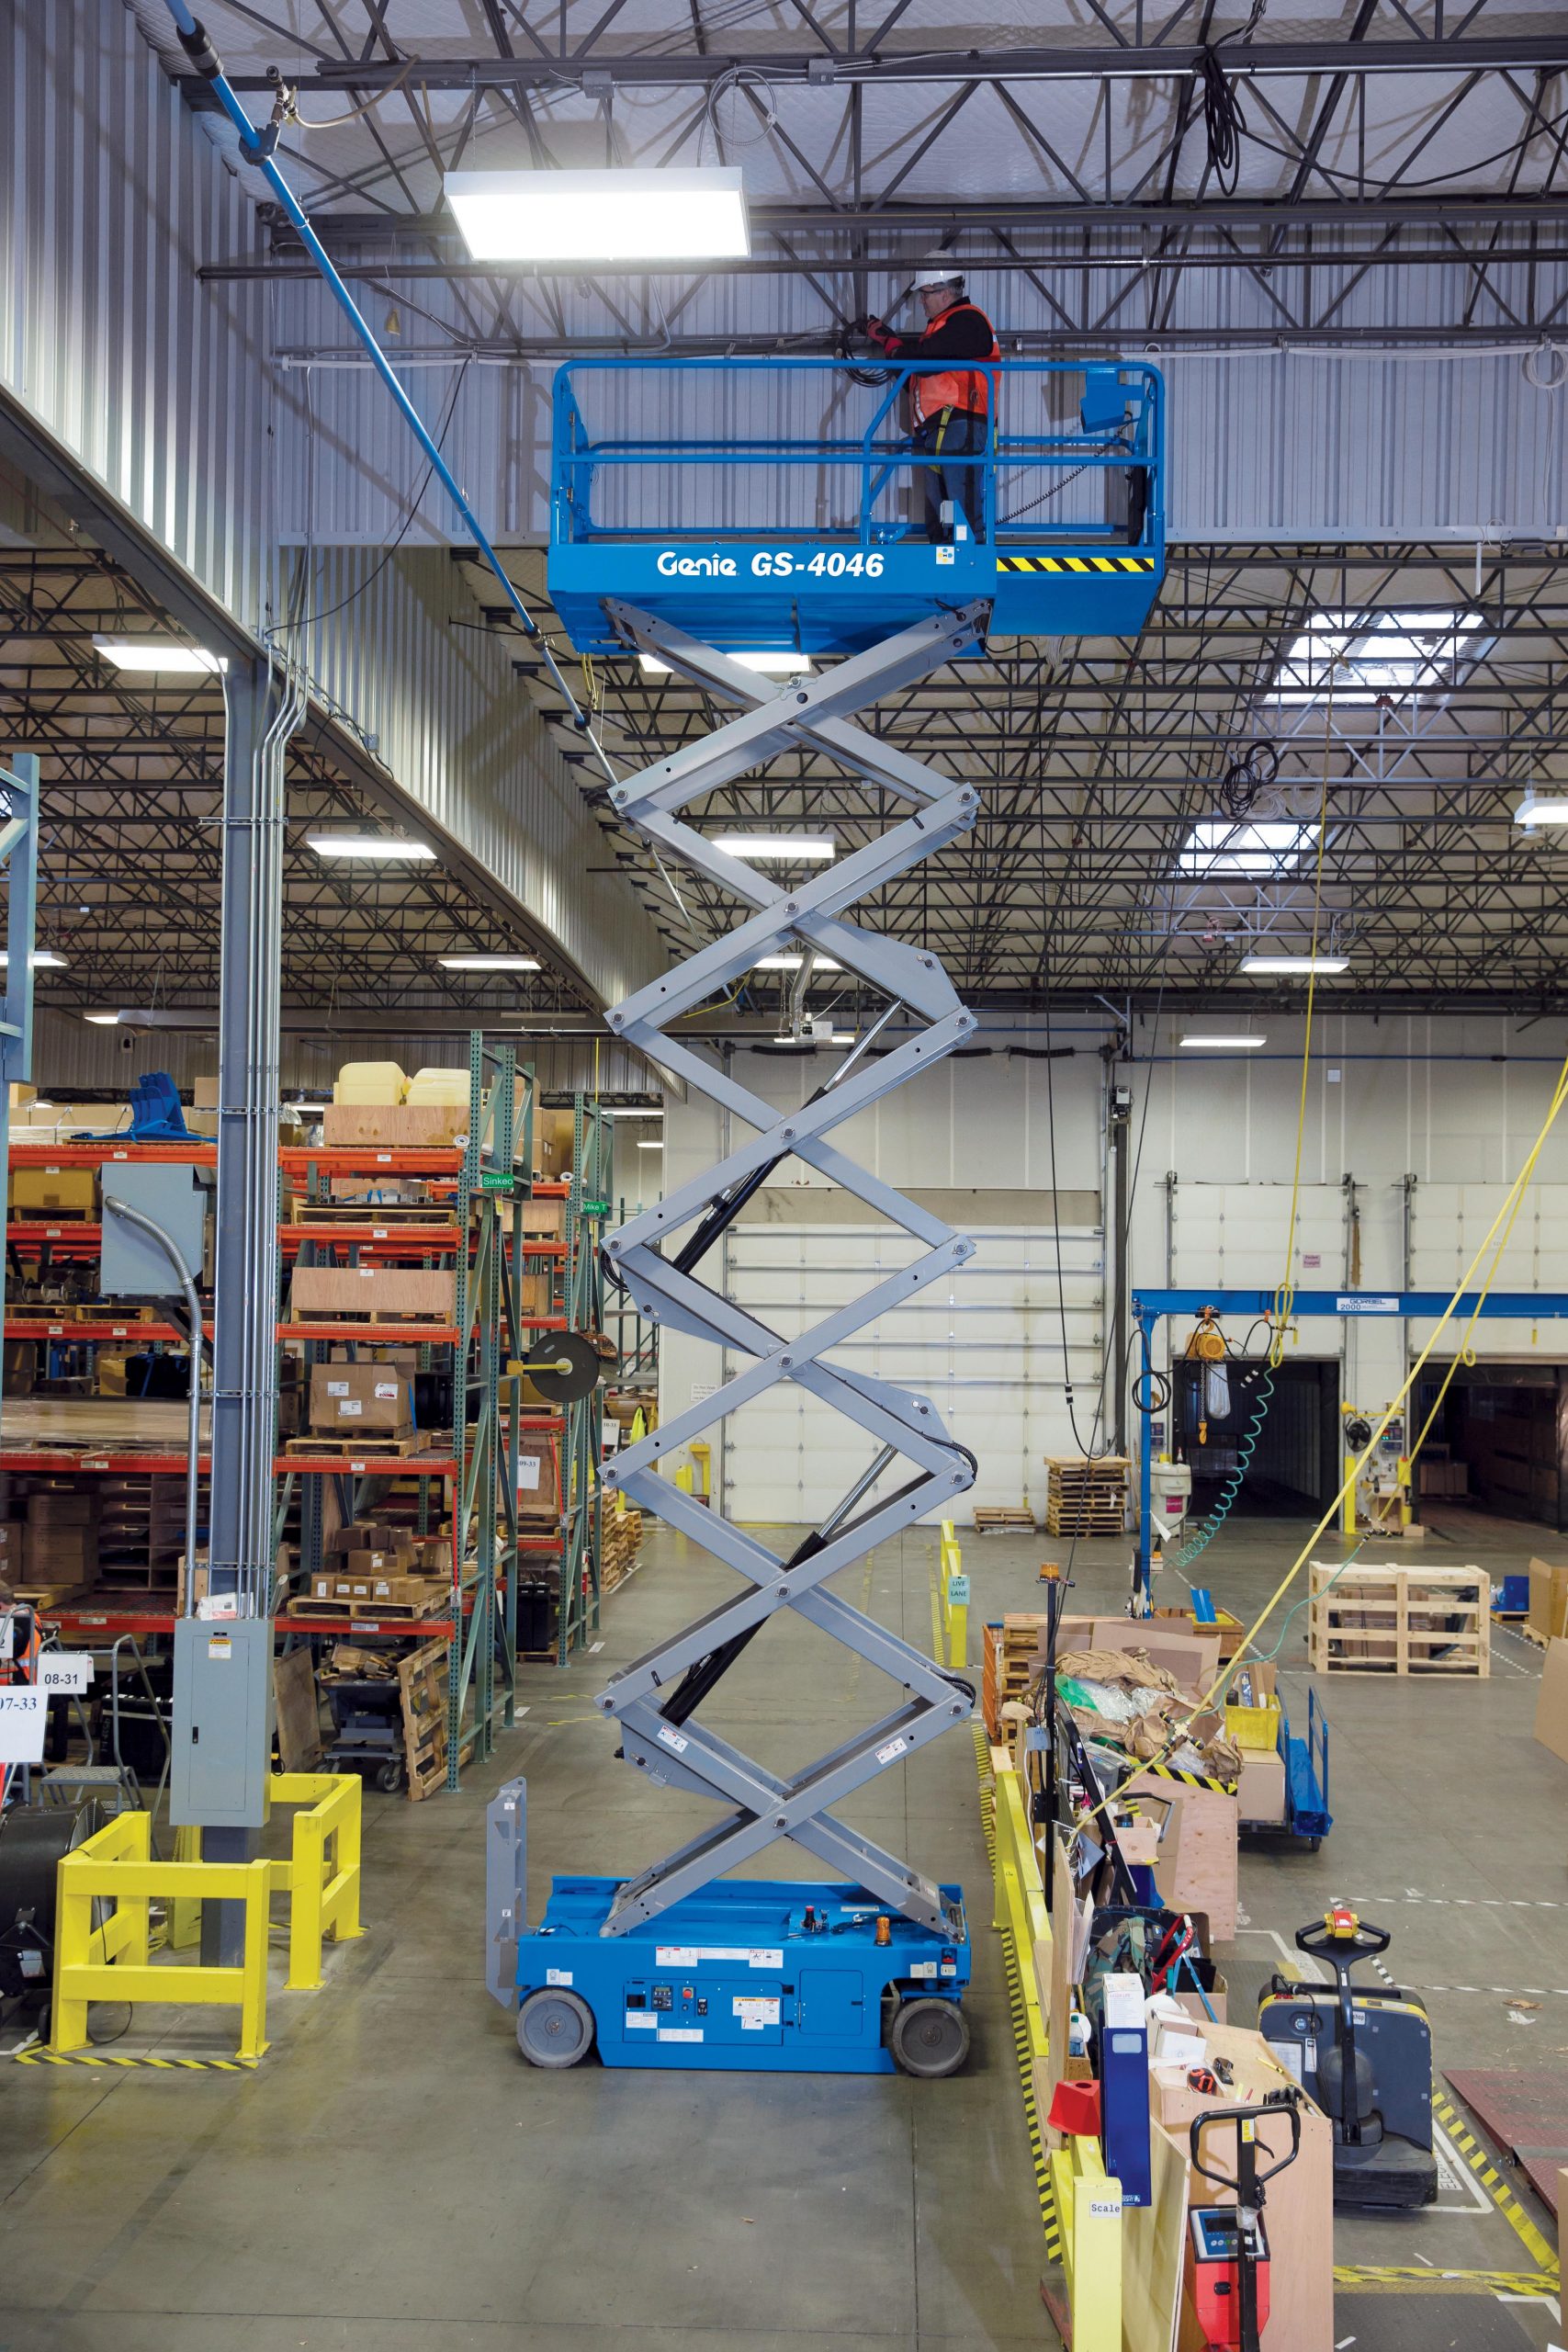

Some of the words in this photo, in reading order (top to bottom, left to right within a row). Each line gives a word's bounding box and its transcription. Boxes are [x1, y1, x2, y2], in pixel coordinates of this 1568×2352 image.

[657, 551, 738, 577] Genie
[750, 551, 885, 578] GS-4046
[483, 1176, 513, 1186] Sinkeo
[44, 1673, 79, 1685] 08-31
[1090, 2203, 1121, 2213] Scale
